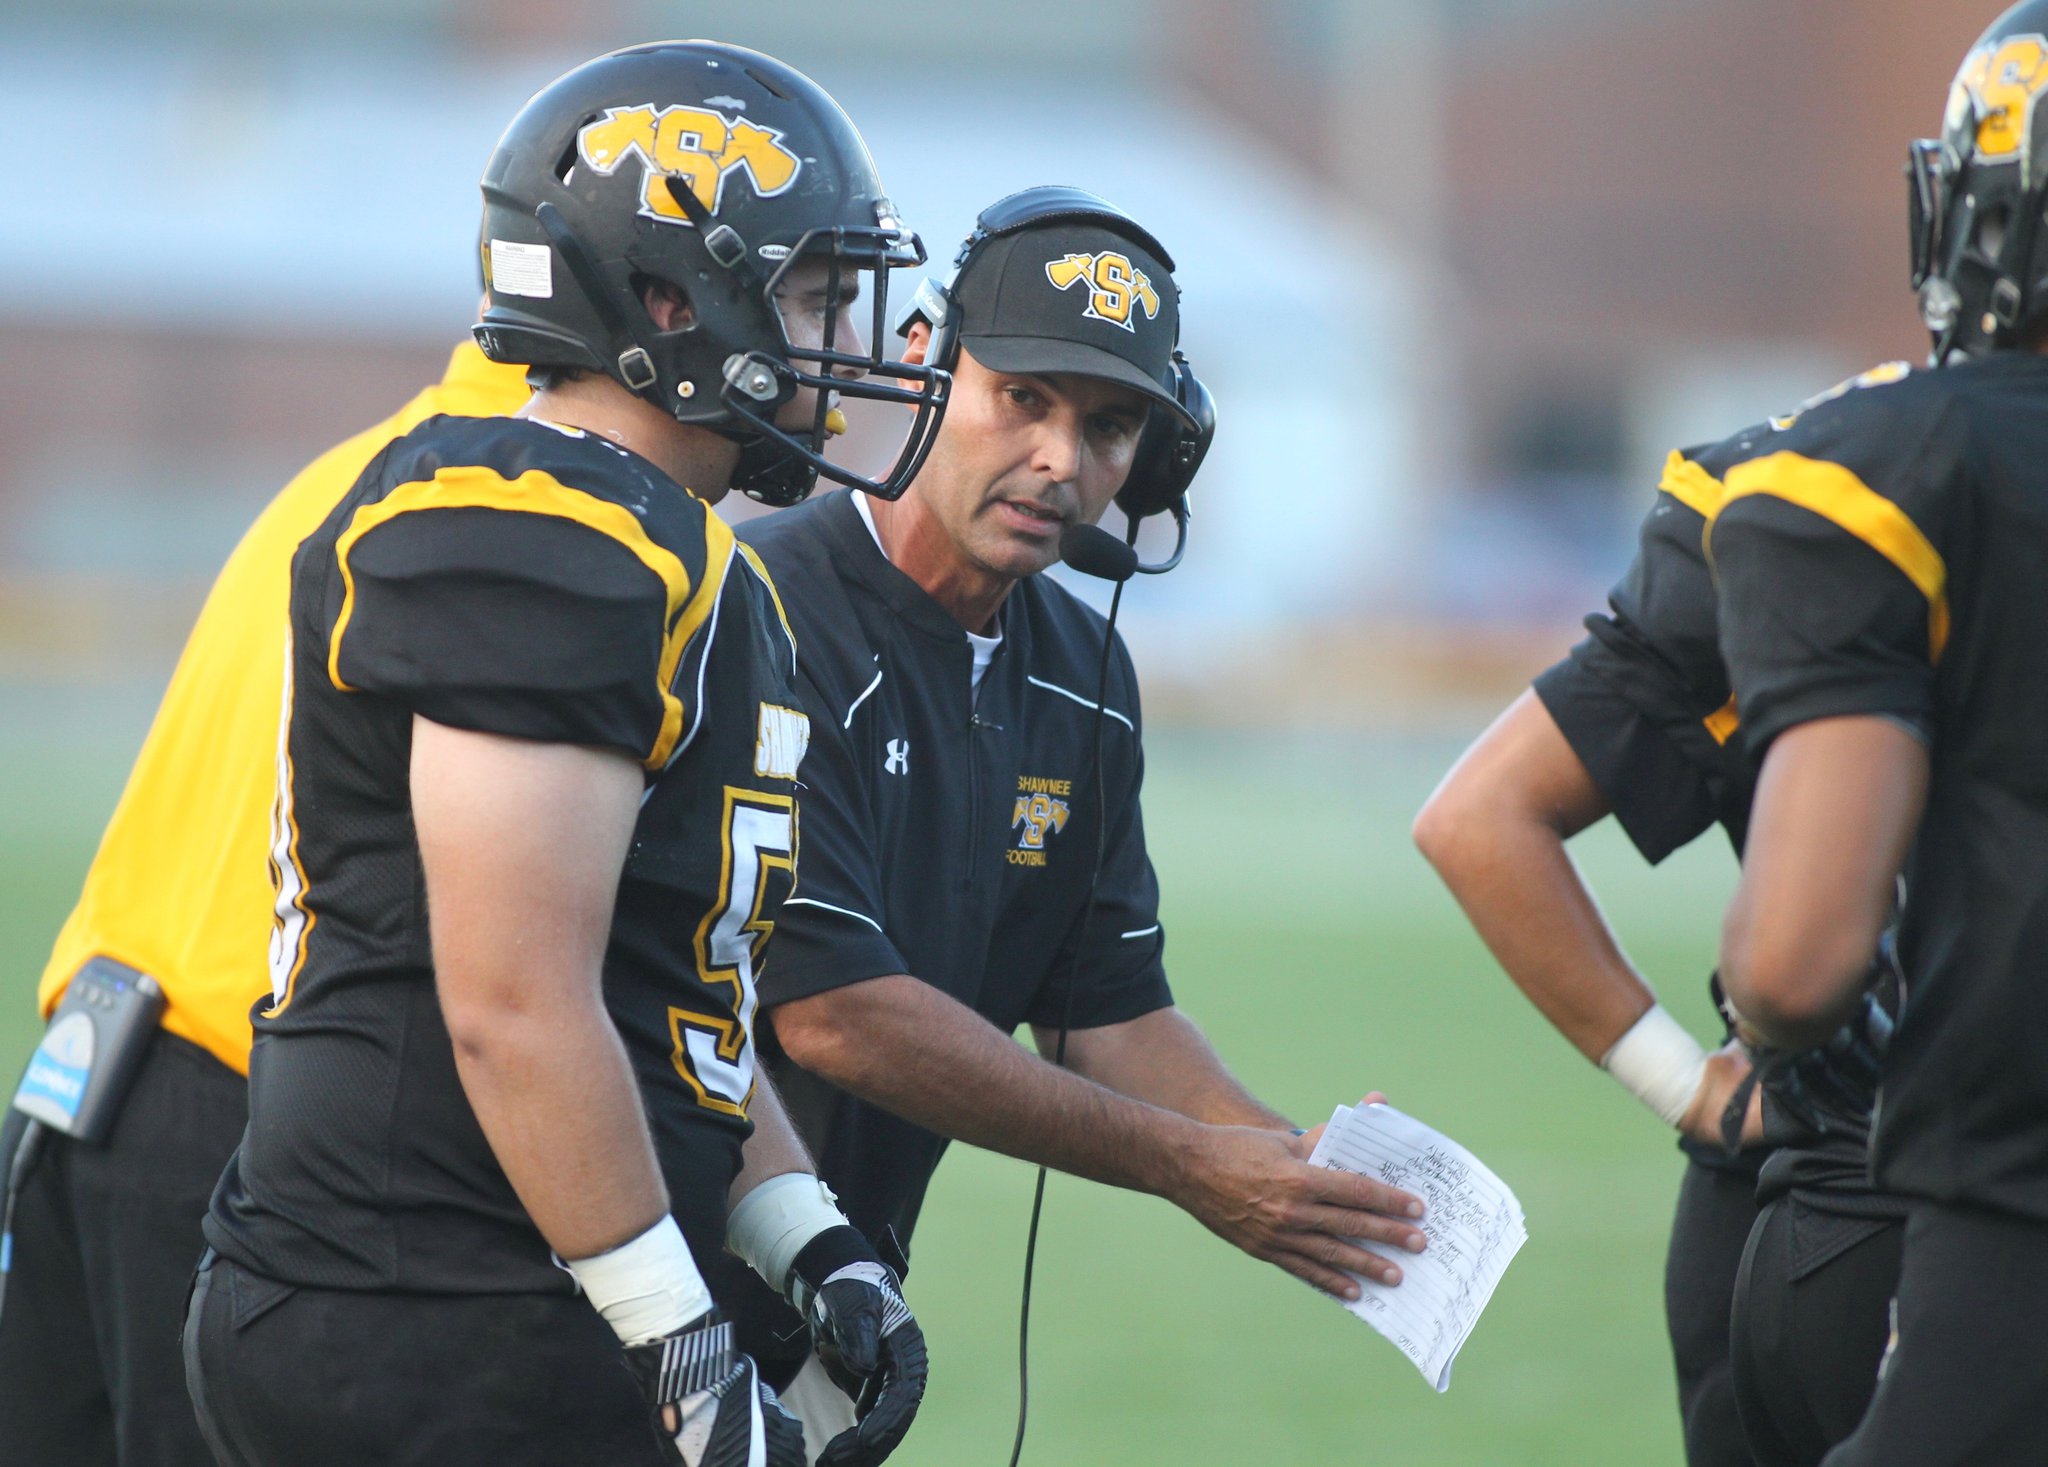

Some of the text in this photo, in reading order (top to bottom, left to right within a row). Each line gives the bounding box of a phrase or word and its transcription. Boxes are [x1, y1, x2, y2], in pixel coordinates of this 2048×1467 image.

[641, 104, 728, 225] S
[1090, 251, 1133, 329] S
[1021, 794, 1050, 848] S
